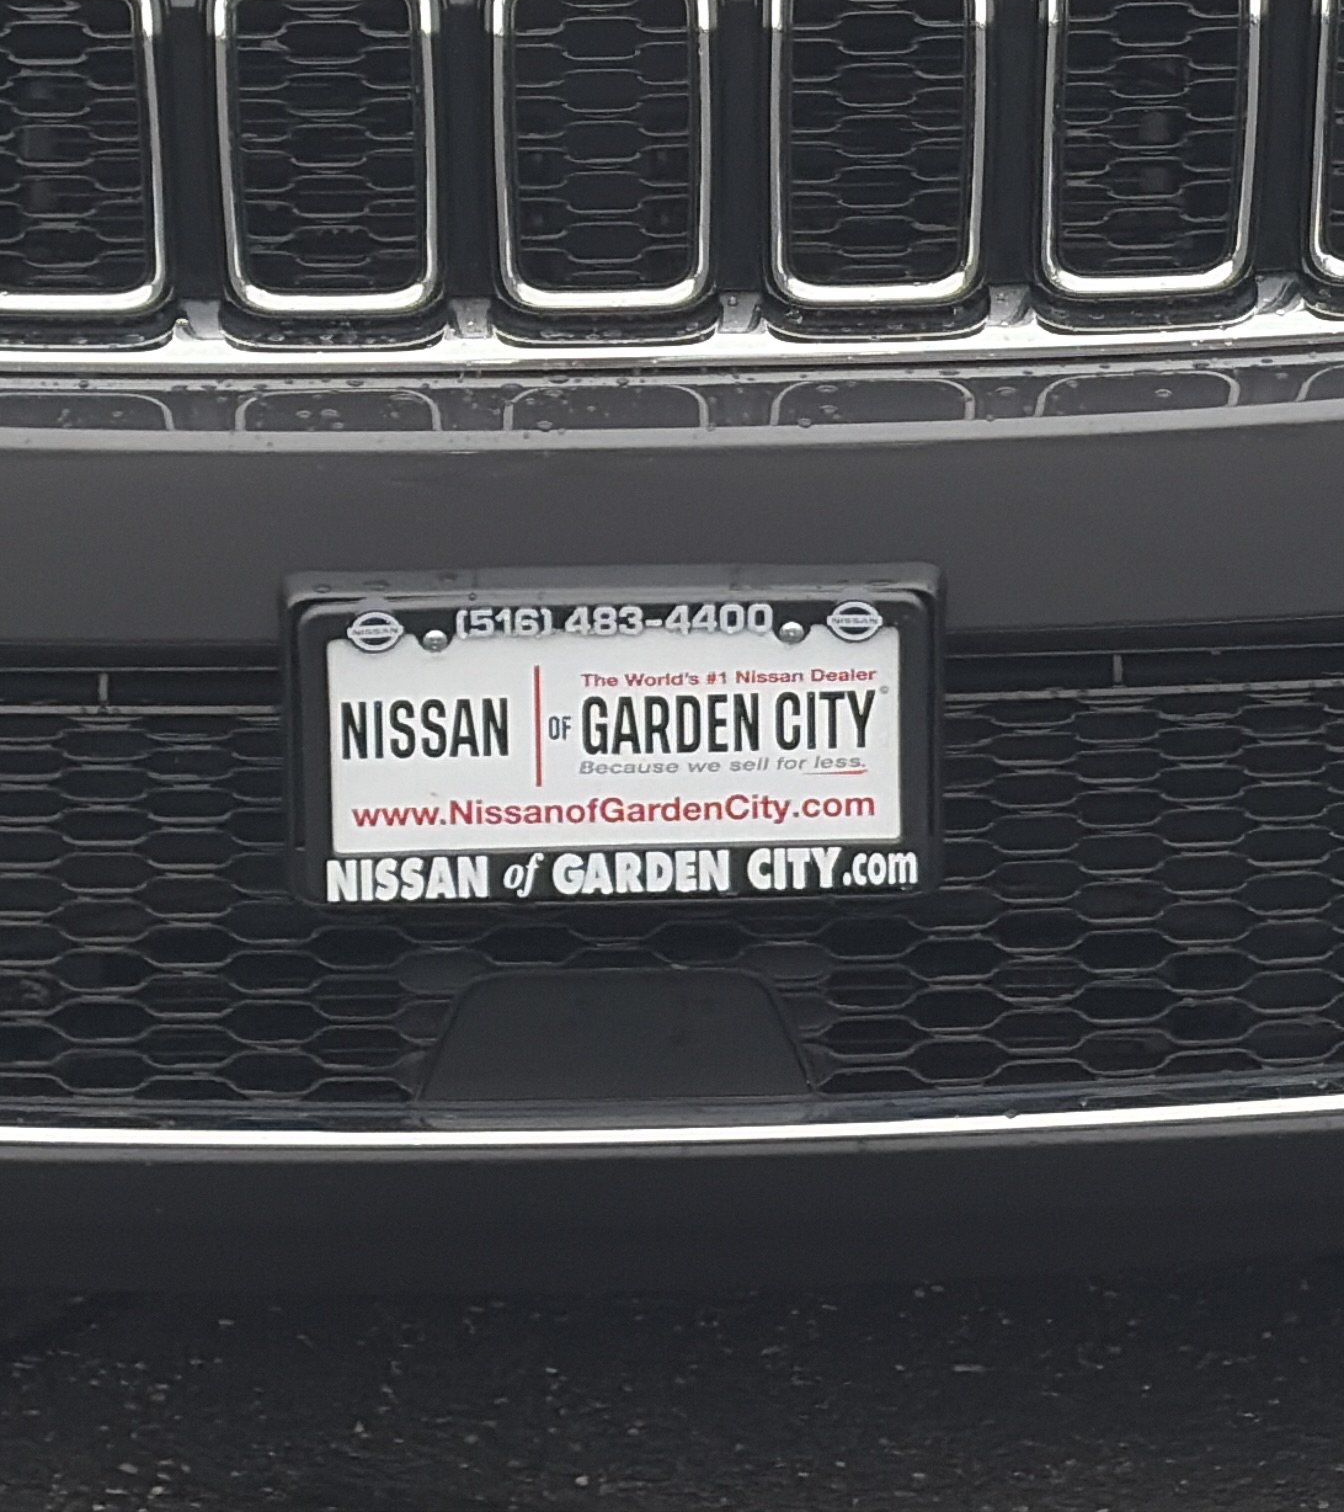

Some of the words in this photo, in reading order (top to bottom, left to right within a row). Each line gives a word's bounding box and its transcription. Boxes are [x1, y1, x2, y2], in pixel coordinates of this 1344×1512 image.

[351, 626, 399, 635] NISSAN
[457, 607, 553, 638] (516)
[565, 603, 774, 636] 483-4400
[831, 616, 879, 625] NISSAN
[581, 672, 618, 687] The
[624, 671, 699, 687] World's
[707, 671, 727, 685] #1
[735, 669, 803, 684] Nissan
[810, 668, 877, 682] Dealer
[341, 697, 509, 760] NISSAN
[548, 715, 572, 741] OF
[581, 692, 761, 755] GARDEN
[775, 689, 876, 751] CITY
[578, 760, 679, 775] Because
[688, 762, 721, 773] we
[730, 757, 769, 771] sell
[777, 756, 807, 770] for
[814, 755, 867, 769] less.
[352, 794, 876, 827] www.NissanofGardenCity.com
[326, 856, 489, 902] NISSAN
[503, 852, 544, 898] of
[552, 849, 731, 895] GARDEN
[747, 846, 918, 890] CITY.com
